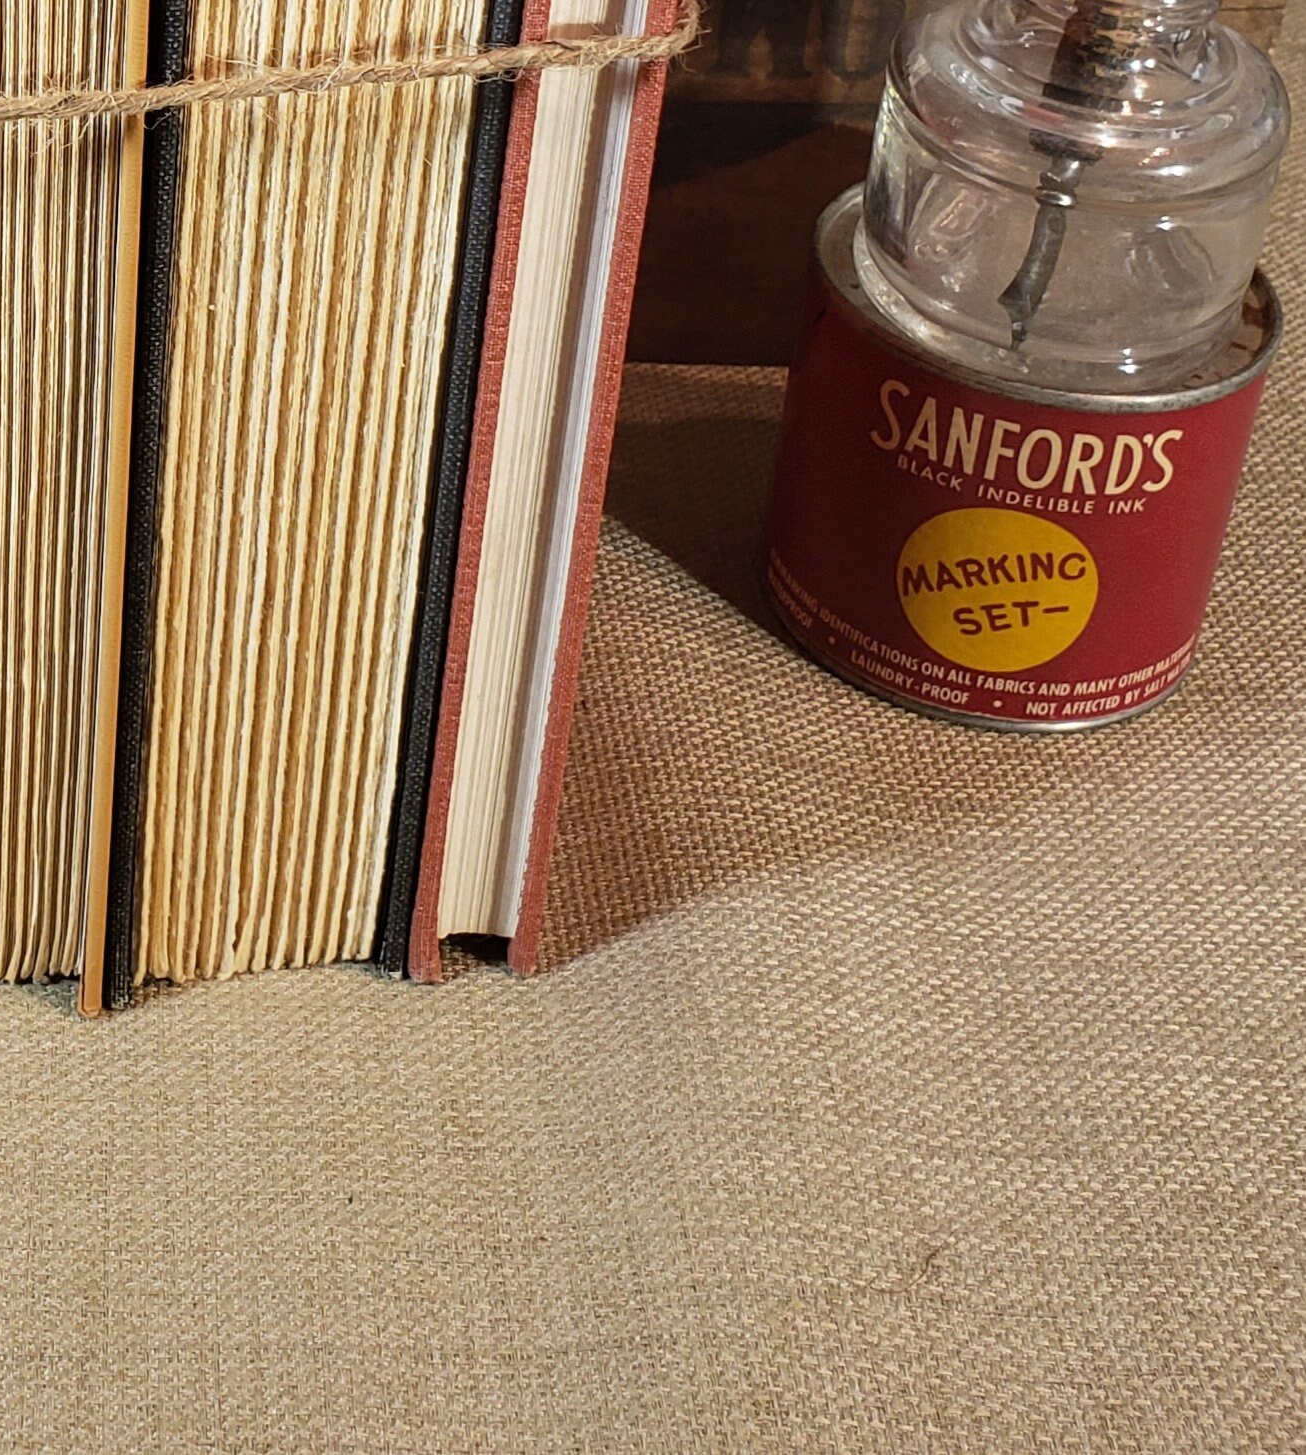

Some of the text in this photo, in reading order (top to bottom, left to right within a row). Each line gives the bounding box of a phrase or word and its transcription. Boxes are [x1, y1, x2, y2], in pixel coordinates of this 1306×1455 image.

[870, 379, 1184, 495] SANFORD'S
[897, 452, 1147, 515] BLACK INDELIBLE INK
[901, 552, 1087, 597] MARKING
[819, 607, 919, 671] IDENTIFICATIONS
[920, 662, 944, 680] ON
[946, 668, 973, 686] ALL
[975, 674, 1036, 695] FABRICS
[1037, 682, 1071, 697] AND
[1073, 676, 1119, 697] MANY
[1118, 665, 1155, 688] OTHER
[1025, 700, 1057, 715] NOT
[1061, 694, 1120, 716] AFFECTED
[1123, 687, 1142, 706] BY
